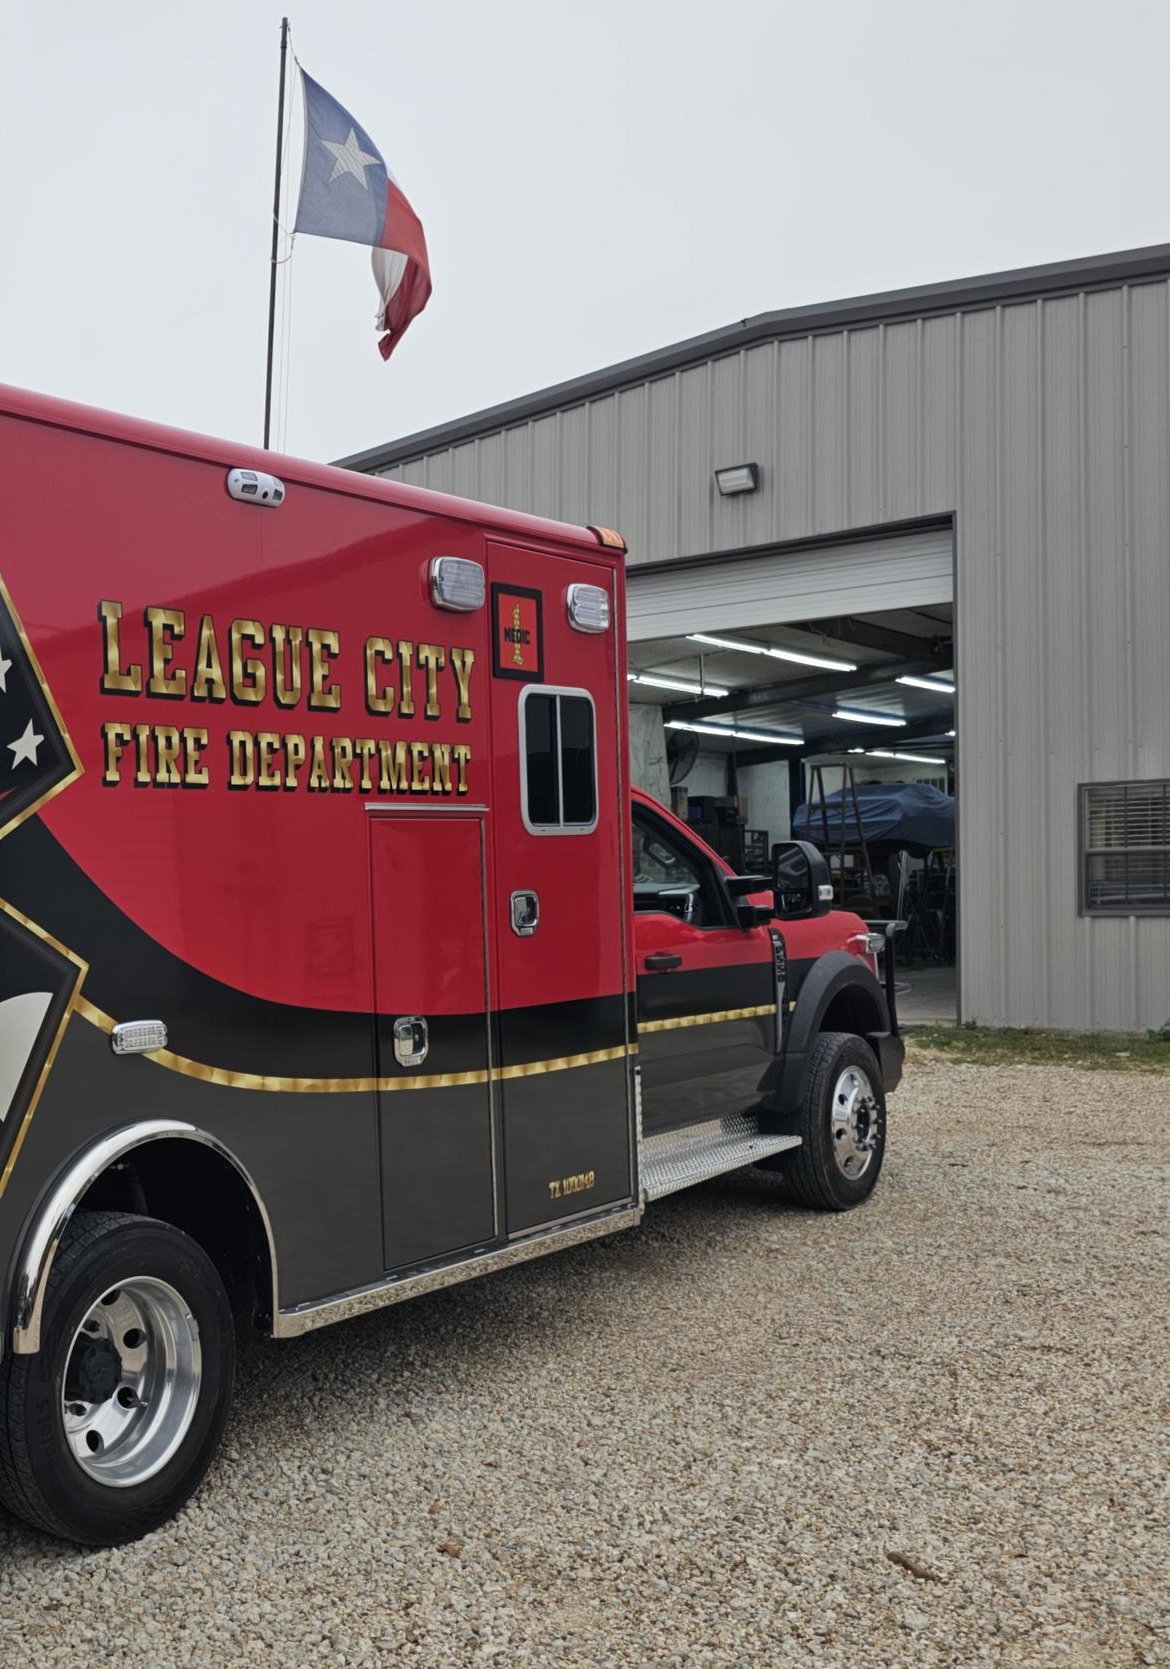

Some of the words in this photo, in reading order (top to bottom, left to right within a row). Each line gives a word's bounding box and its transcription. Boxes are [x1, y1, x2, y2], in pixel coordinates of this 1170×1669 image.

[98, 600, 341, 711] LEAGUE
[365, 636, 475, 721] CITY
[504, 627, 531, 645] MEDIC
[101, 721, 209, 787] FIRE
[228, 729, 472, 795] DEPARTMENT
